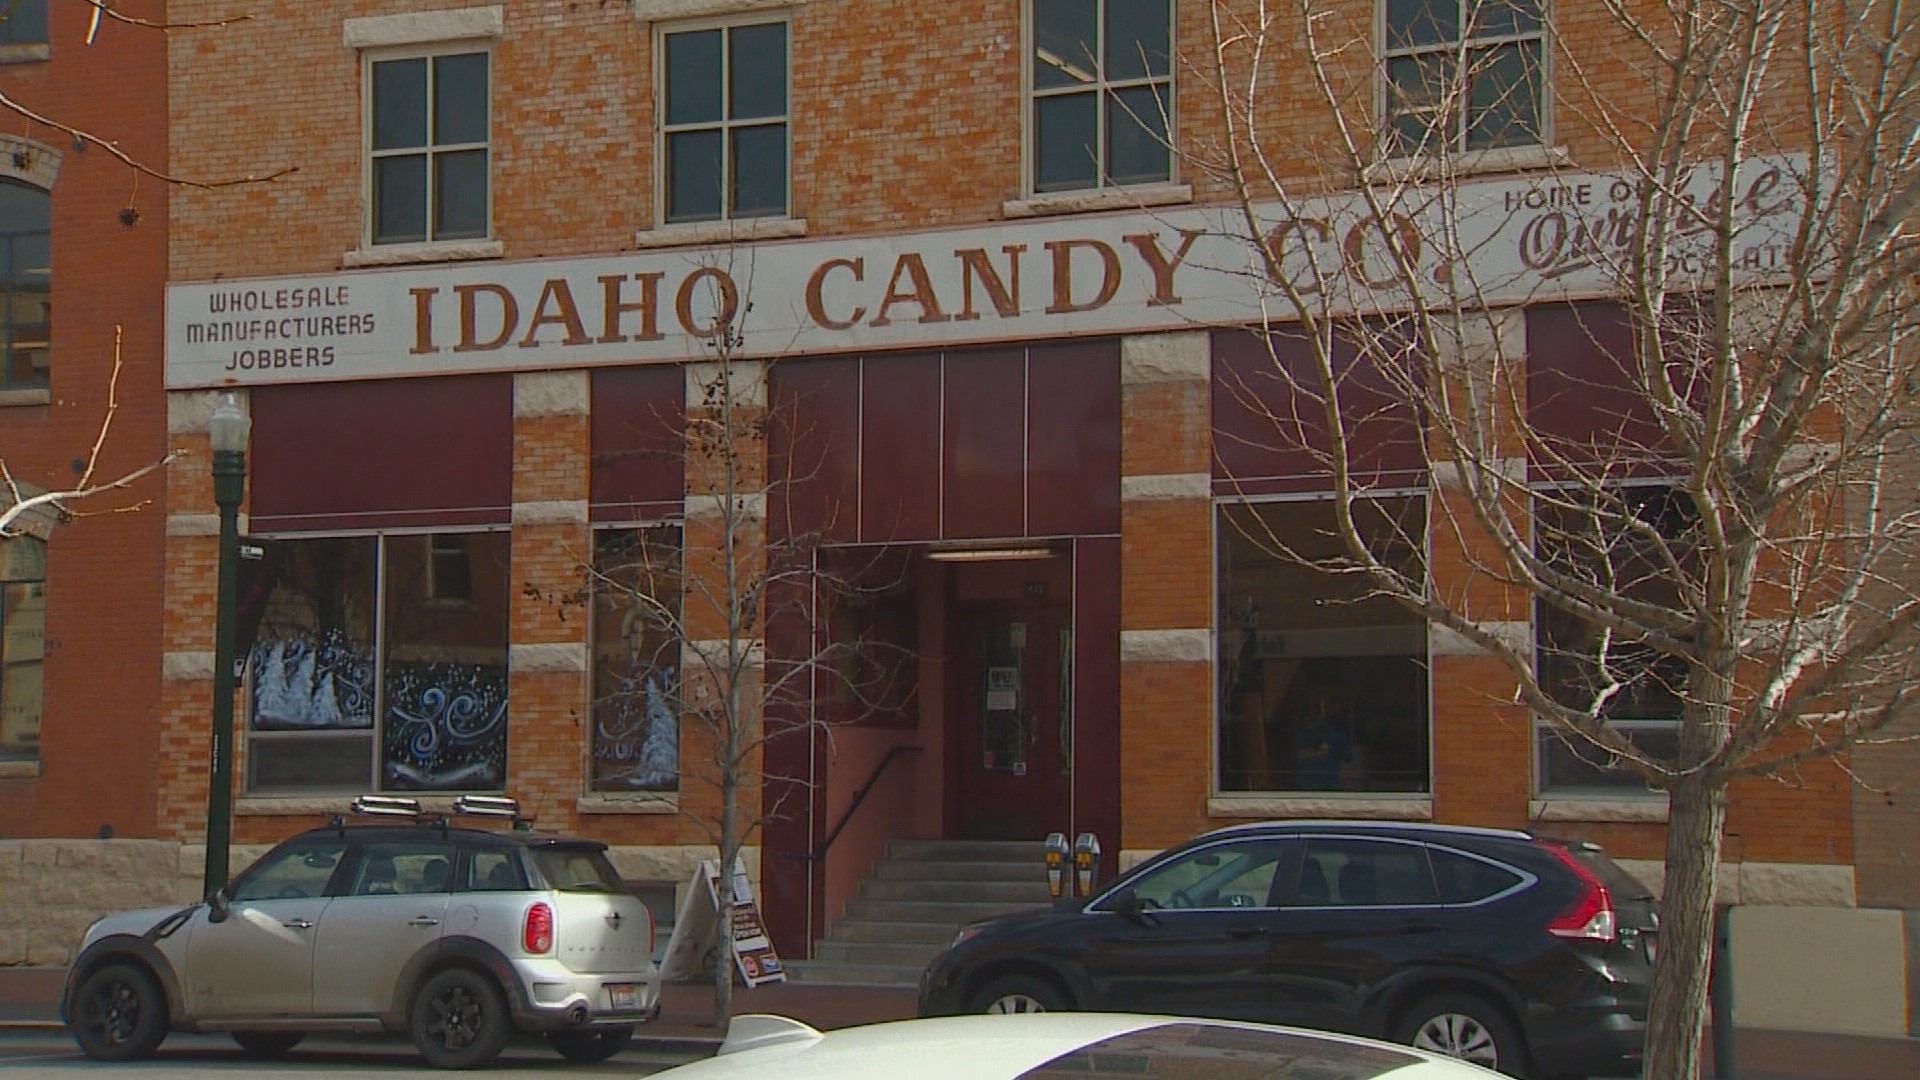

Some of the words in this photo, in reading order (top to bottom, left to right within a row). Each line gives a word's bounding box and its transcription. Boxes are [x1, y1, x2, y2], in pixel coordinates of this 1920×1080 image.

[1504, 184, 1592, 212] HOME
[408, 266, 739, 355] IDAHO
[805, 229, 1207, 331] CANDY
[1264, 211, 1453, 296] CO.
[208, 286, 350, 314] WHOLESALE
[186, 313, 376, 344] MANUFACTURERS
[225, 345, 335, 371] JOBBERS
